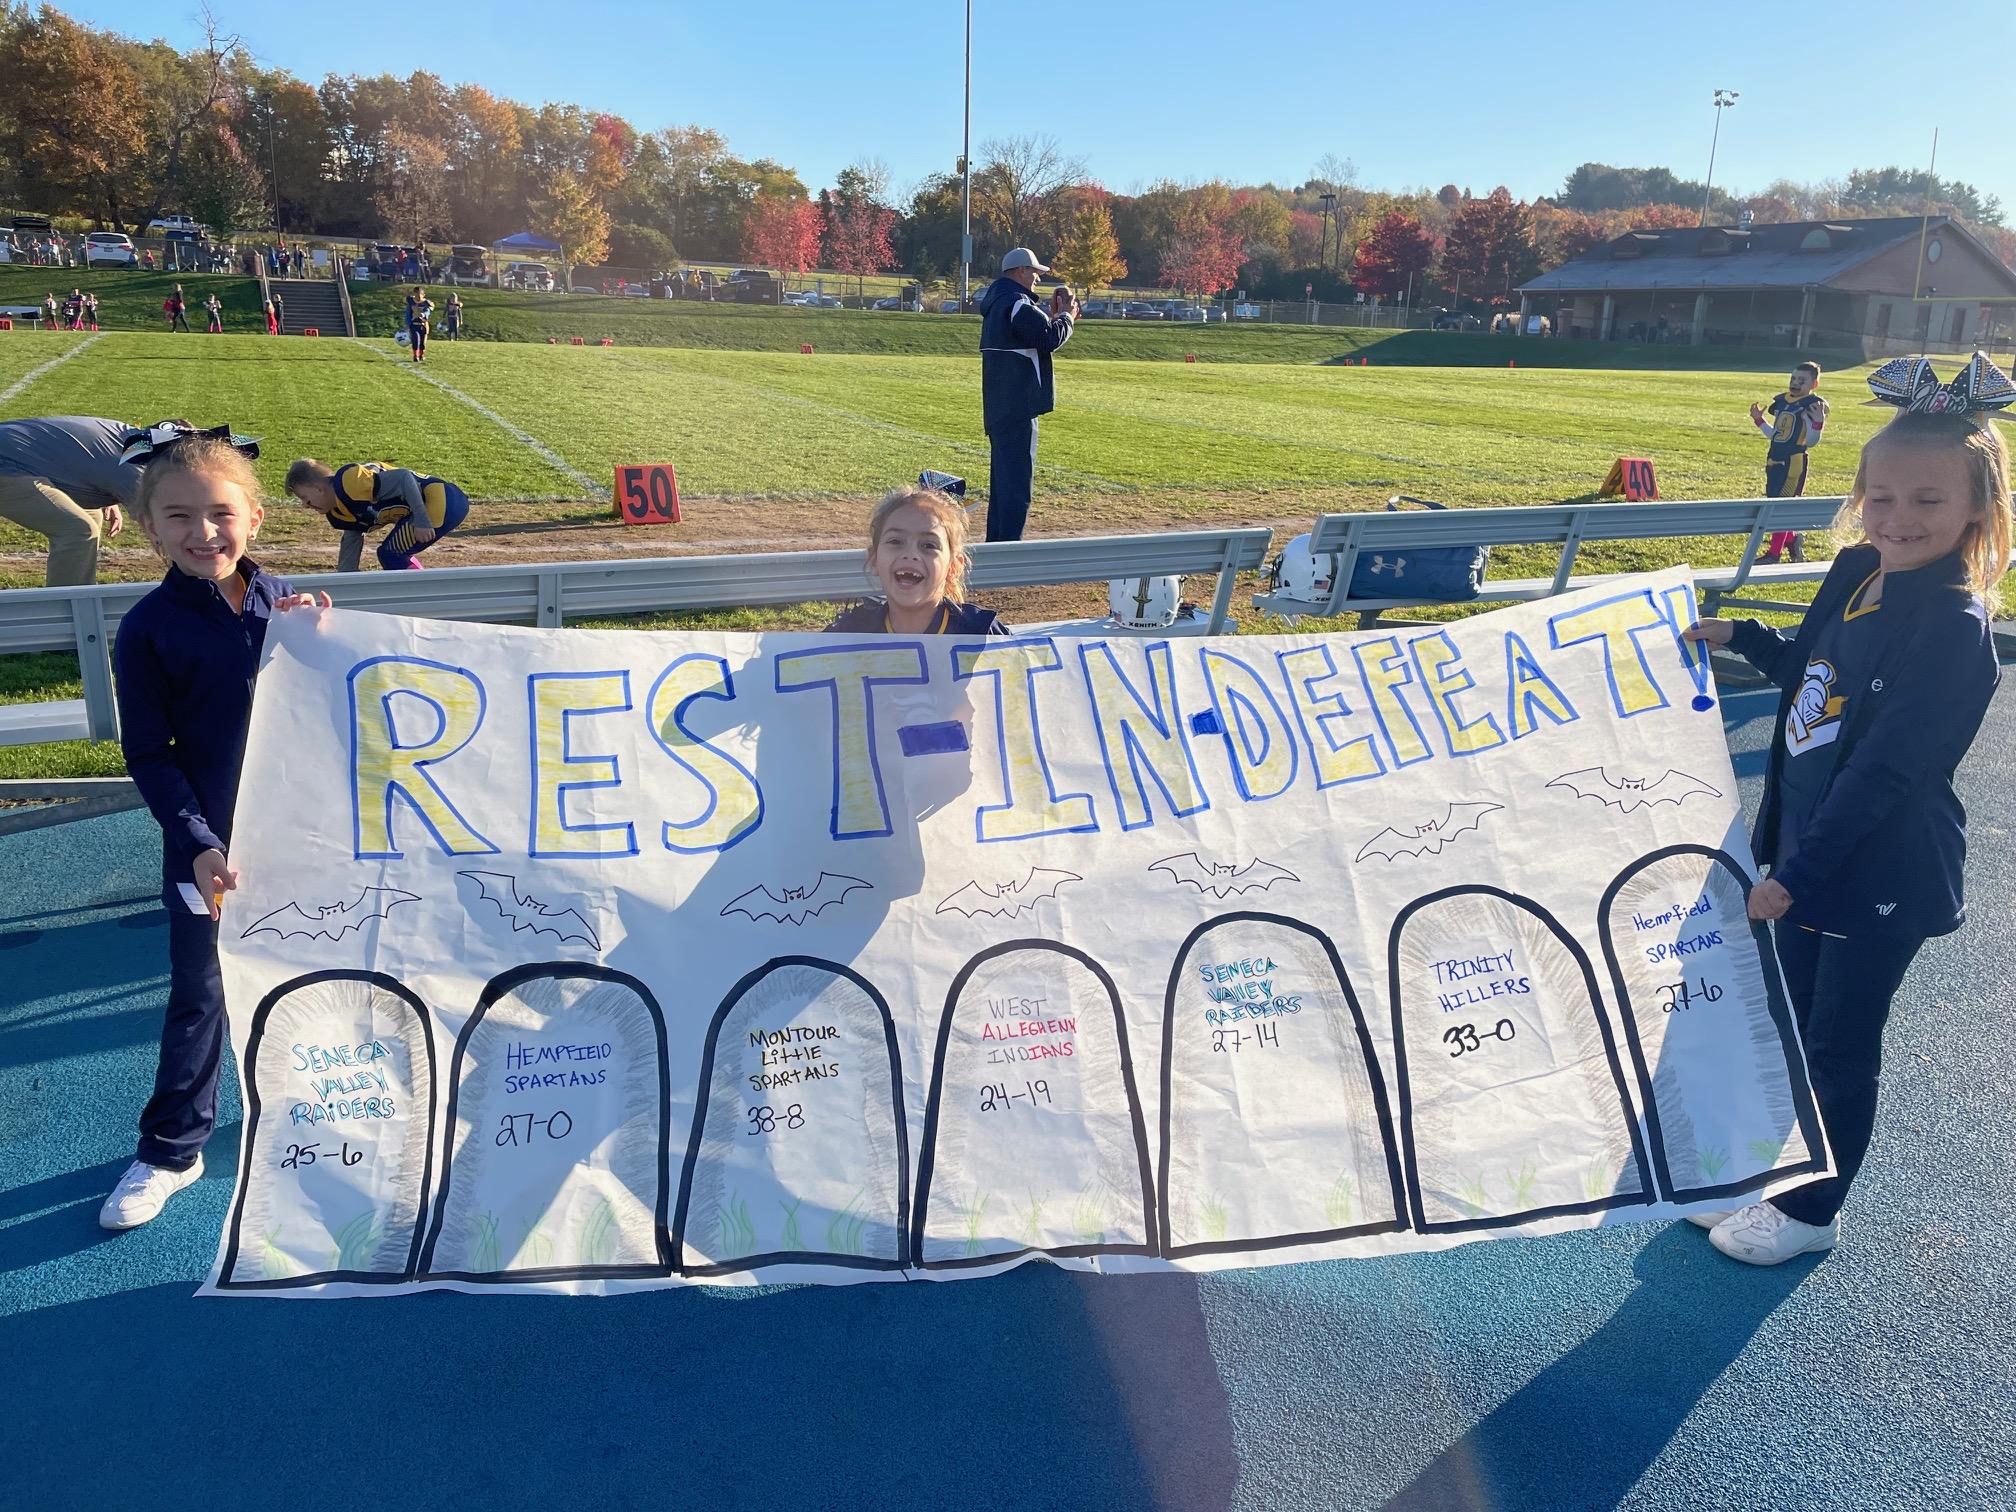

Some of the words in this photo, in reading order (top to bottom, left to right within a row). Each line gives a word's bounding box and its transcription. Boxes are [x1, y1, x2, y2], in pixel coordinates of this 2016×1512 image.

[624, 467, 674, 519] 50
[1629, 460, 1655, 498] 40
[1632, 894, 1713, 932] Hempfield
[1645, 930, 1724, 964] SPARTANS
[1198, 956, 1279, 984] SENECA
[1429, 948, 1514, 985] TRINITY
[988, 996, 1047, 1019] WEST
[1205, 995, 1303, 1028] RAIDERS
[1438, 977, 1531, 1013] HILLERS
[1655, 977, 1723, 1013] 27-6
[749, 1025, 841, 1048] MONTOUR
[982, 1017, 1077, 1041] ALLEGHENY
[1212, 1021, 1279, 1053] 27-14
[1442, 1018, 1516, 1059] 33-0
[291, 1040, 390, 1074] SENECA
[987, 1041, 1073, 1064] INDIANS
[310, 1067, 390, 1103] VALLEY
[504, 1069, 607, 1094] SPARTANS
[980, 1079, 1052, 1112] 24-19
[495, 1110, 573, 1147] 27-0
[747, 1103, 806, 1136] 38-8
[280, 1142, 363, 1170] 25-6
